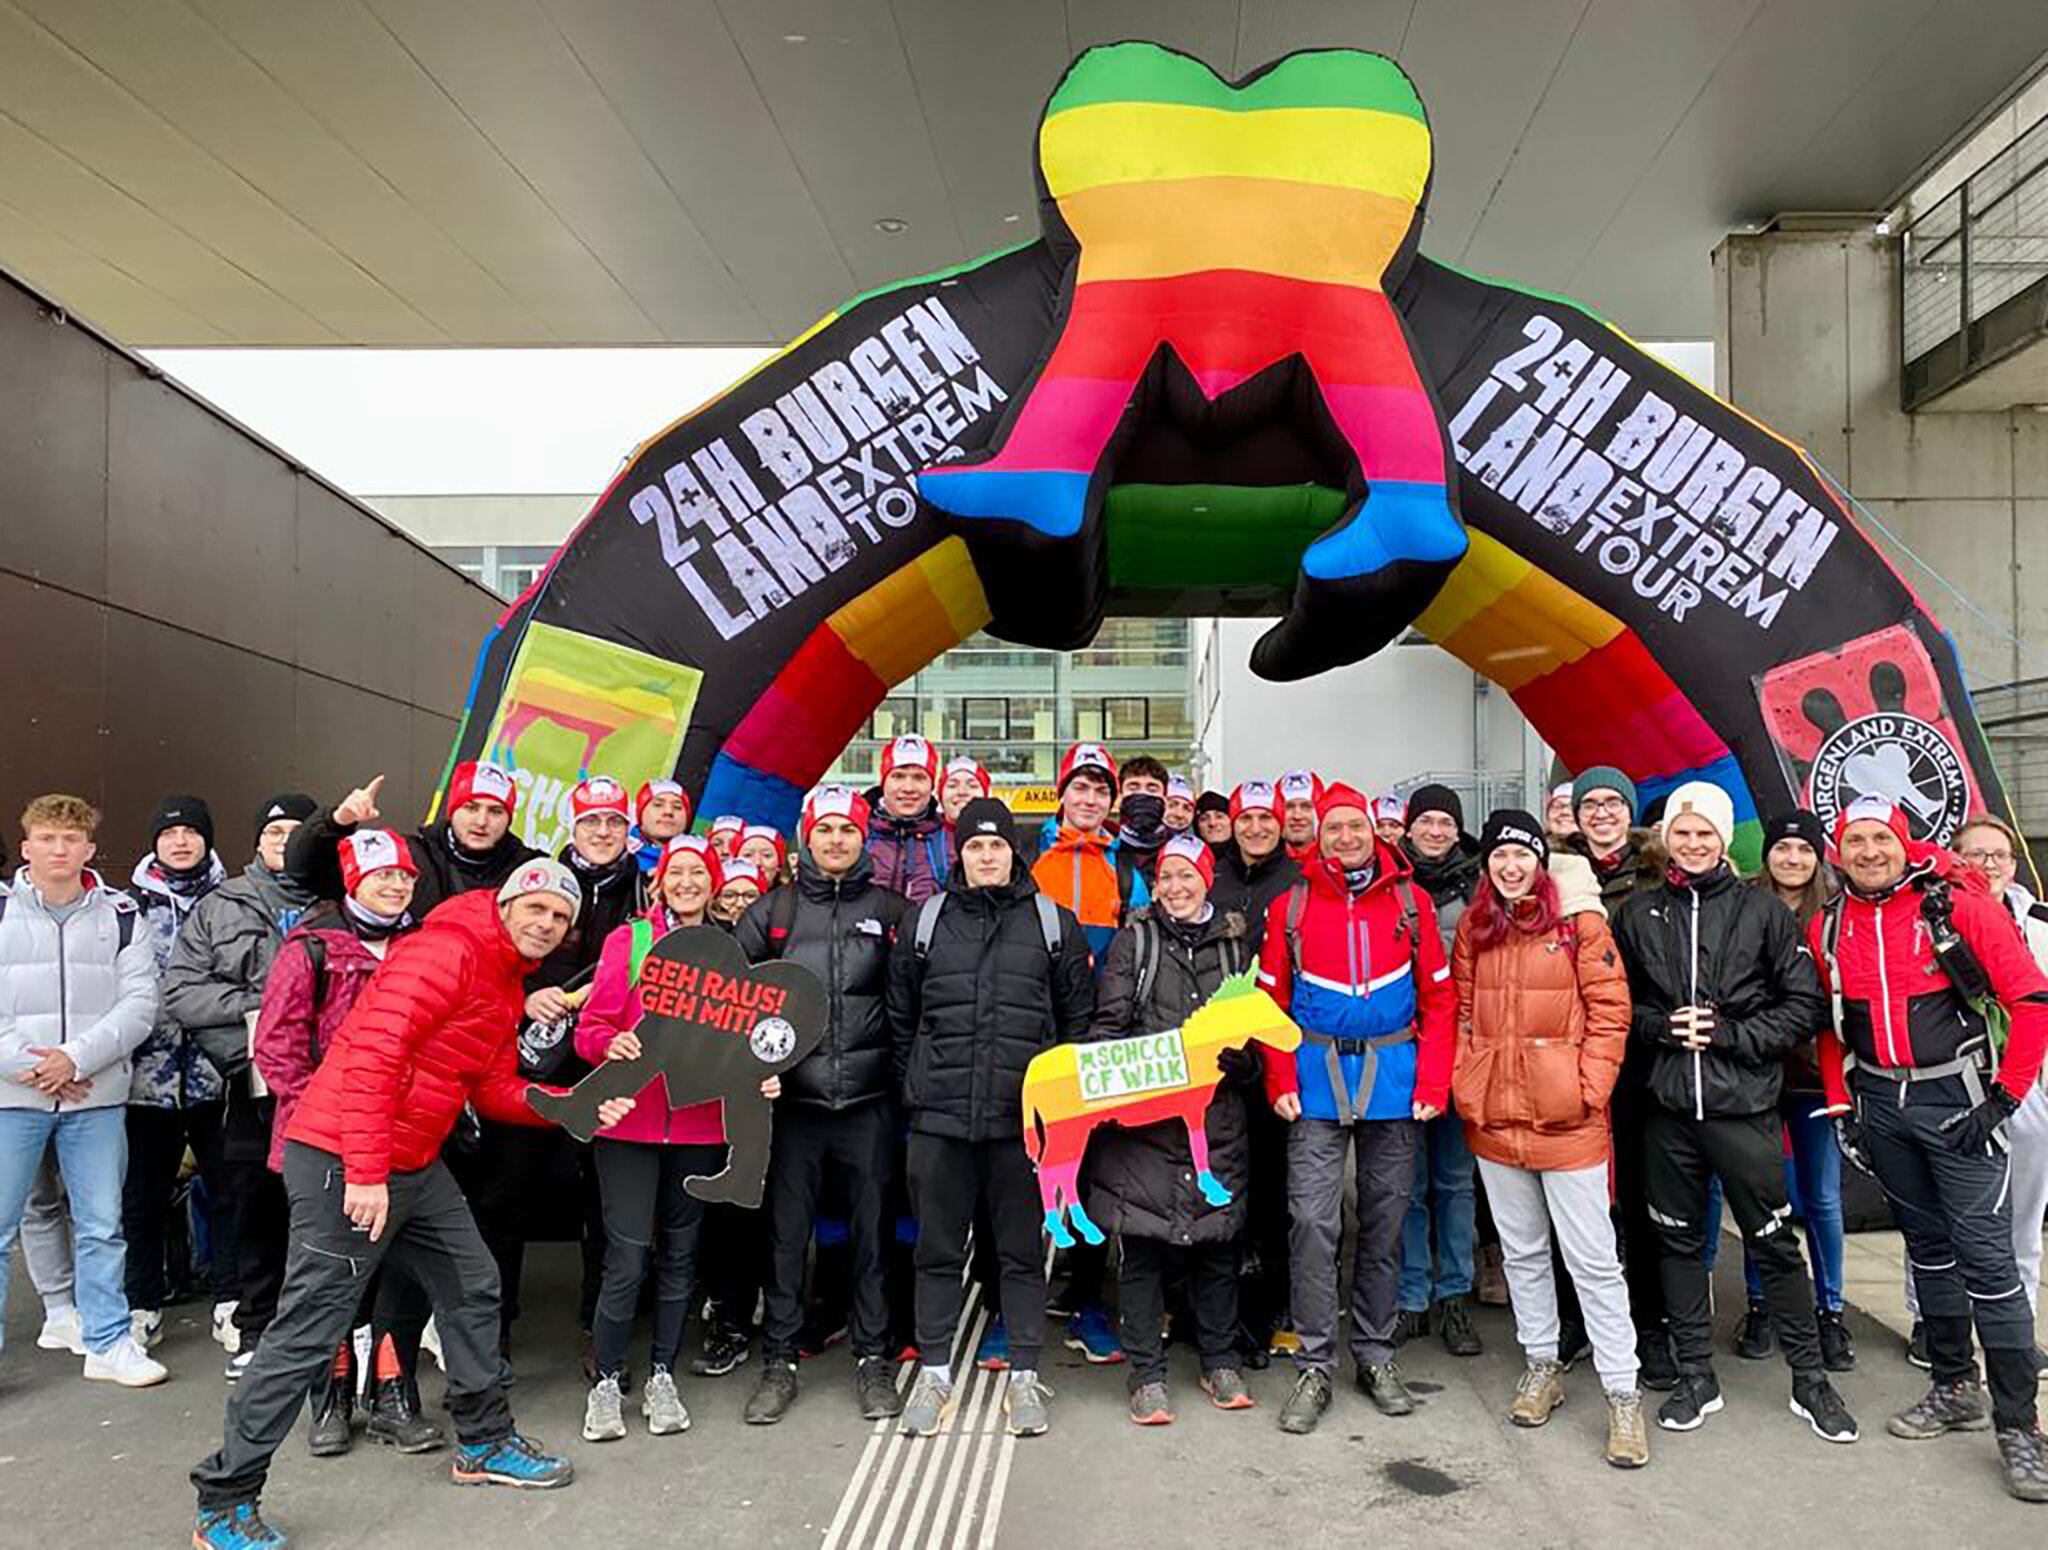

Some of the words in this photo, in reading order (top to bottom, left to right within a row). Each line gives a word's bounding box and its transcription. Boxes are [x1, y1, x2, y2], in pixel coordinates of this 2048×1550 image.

[629, 438, 765, 567] 24H
[739, 296, 981, 490] BURGEN
[816, 365, 1008, 514] EXTREM
[844, 445, 966, 544] TO
[1448, 377, 1615, 536] LAND
[1490, 314, 1632, 439] 24H
[1602, 390, 1840, 591] BURGEN
[675, 484, 859, 640] LAND
[1574, 514, 1702, 622] TOUR
[1596, 476, 1789, 630] EXTREM
[1901, 722, 1961, 789] EXTREM
[639, 955, 700, 992] GEH
[703, 972, 787, 1015] RAUS!
[639, 985, 697, 1021] GEH
[698, 999, 758, 1036] MIT!
[1120, 1059, 1185, 1089] WALK
